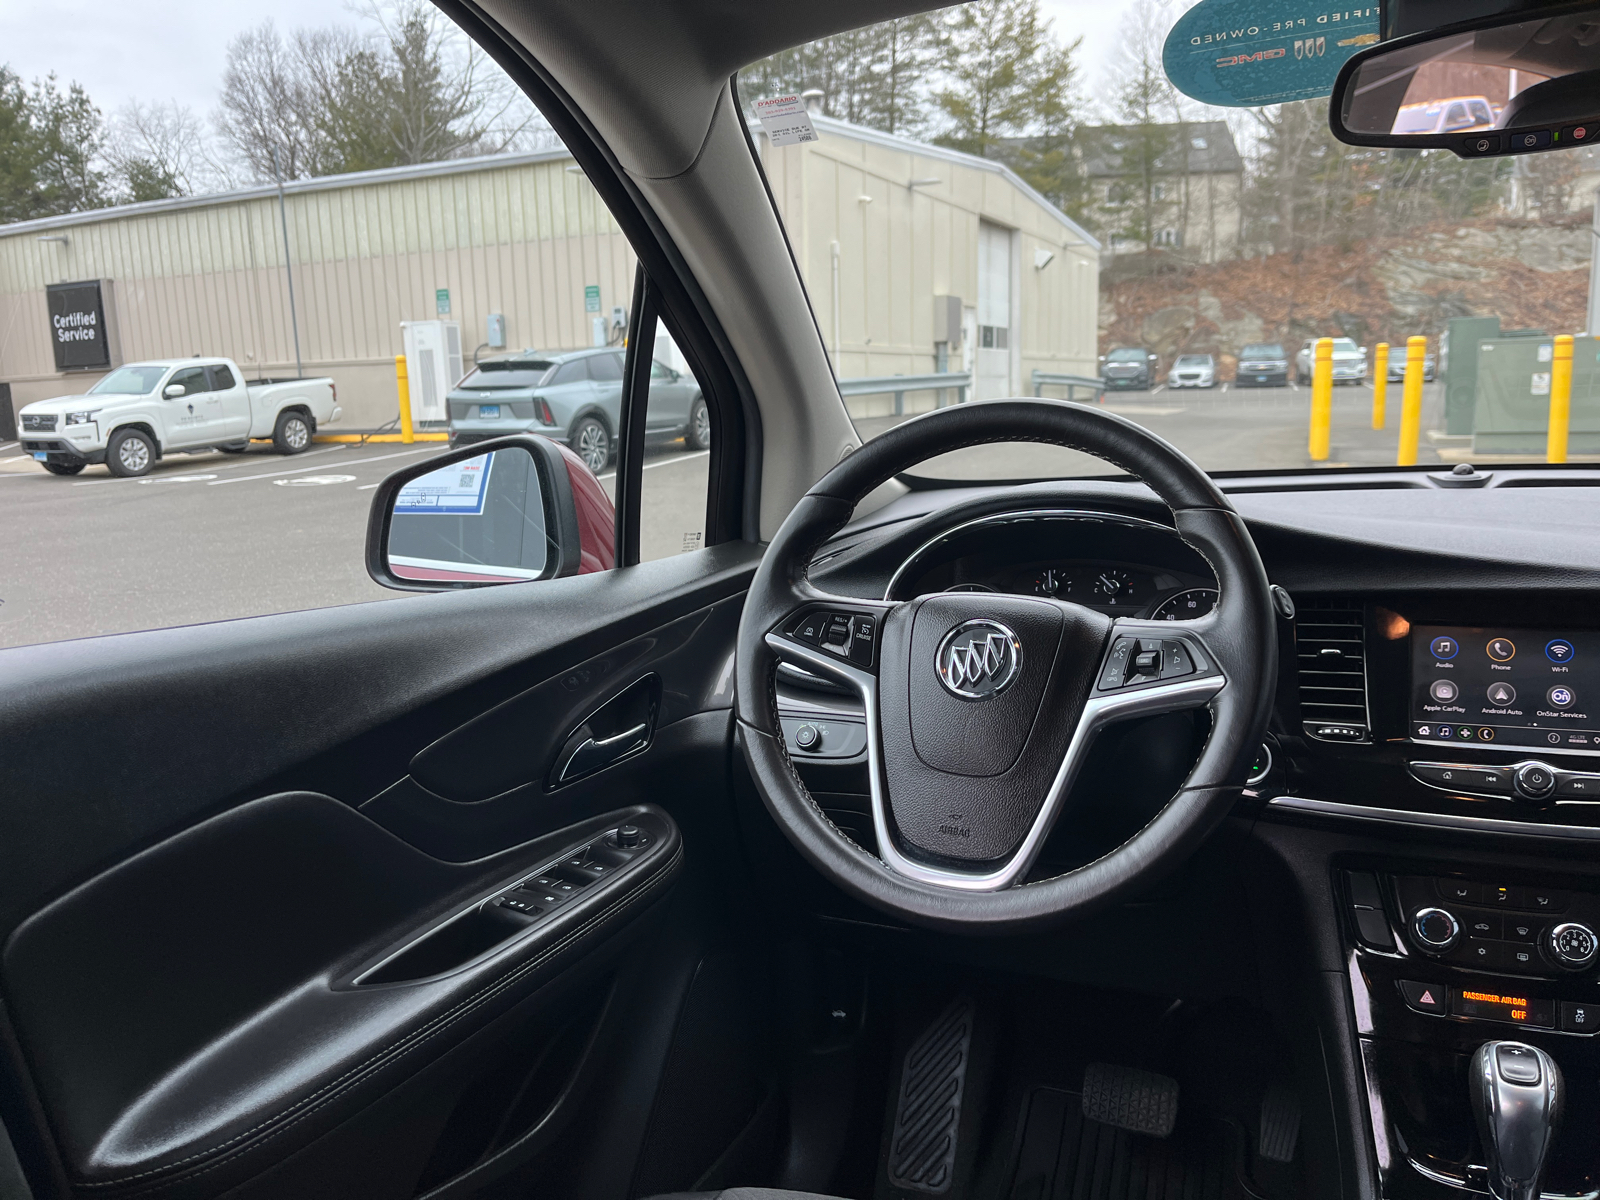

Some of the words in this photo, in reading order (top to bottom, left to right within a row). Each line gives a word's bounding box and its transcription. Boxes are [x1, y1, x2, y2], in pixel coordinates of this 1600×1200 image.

[758, 96, 797, 106] D'ADDARIO
[53, 310, 97, 329] Certified
[57, 326, 95, 343] Service
[856, 633, 872, 641] CRUISE
[1553, 692, 1570, 701] On
[1423, 704, 1442, 712] Apple
[1442, 705, 1466, 714] CarPlay
[1481, 707, 1506, 715] Android
[1507, 708, 1523, 716] Auto
[1536, 710, 1559, 718] OnStar
[1463, 991, 1500, 1003] PASSENGER
[1501, 996, 1513, 1005] AIR
[1513, 998, 1527, 1007] BAG
[1511, 1010, 1527, 1020] OFF
